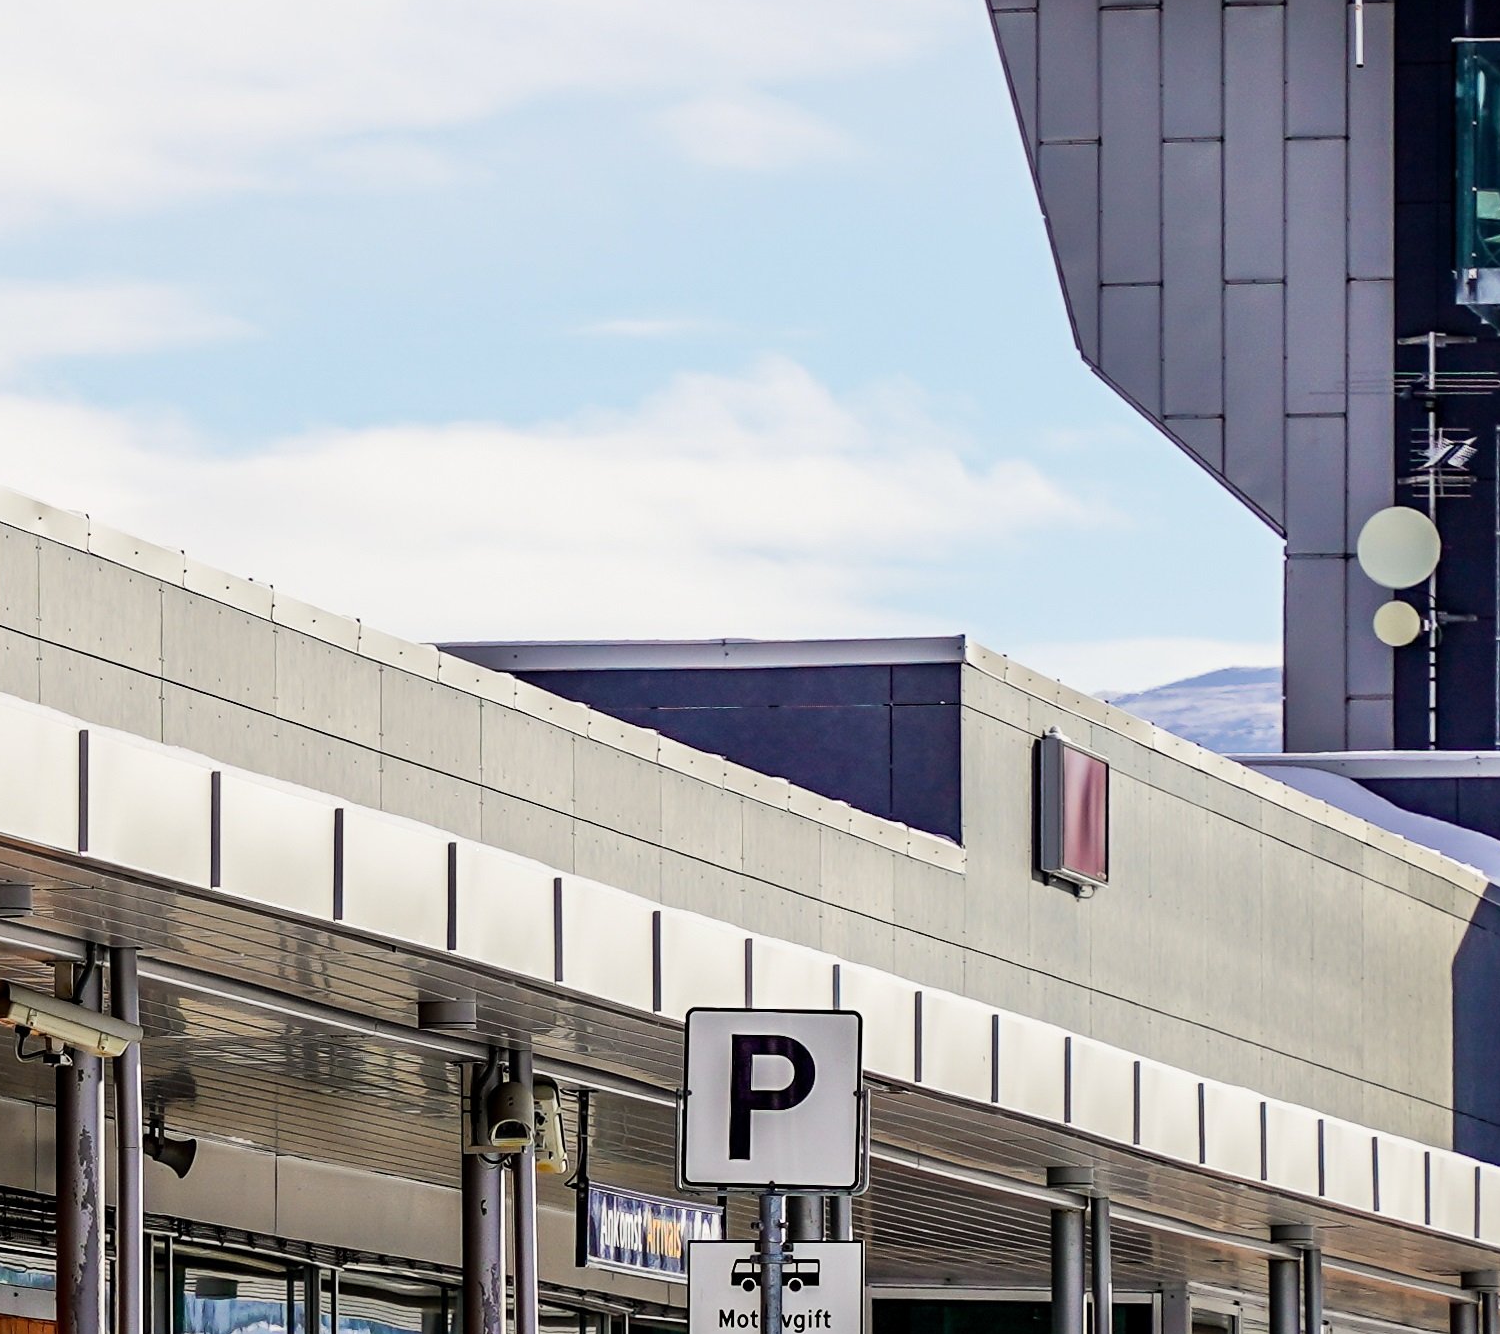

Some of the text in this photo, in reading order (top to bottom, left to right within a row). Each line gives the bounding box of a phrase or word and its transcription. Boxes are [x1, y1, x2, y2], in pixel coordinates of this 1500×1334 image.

[728, 1033, 817, 1161] P
[601, 1198, 682, 1259] Ankomst Arrivals
[718, 1309, 832, 1333] Mot vgift
